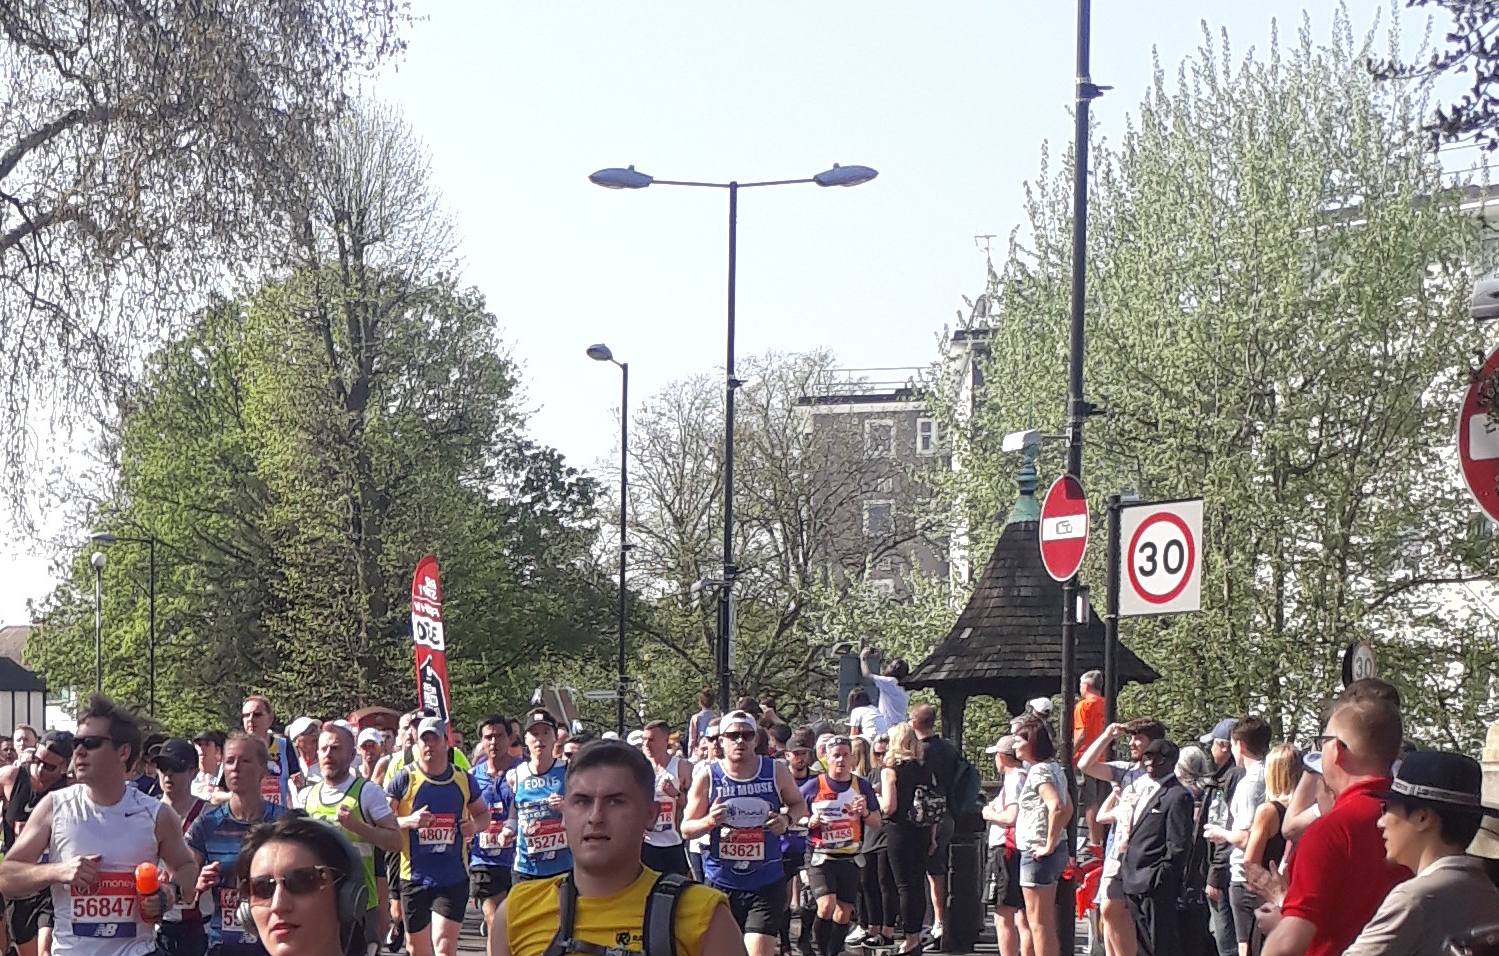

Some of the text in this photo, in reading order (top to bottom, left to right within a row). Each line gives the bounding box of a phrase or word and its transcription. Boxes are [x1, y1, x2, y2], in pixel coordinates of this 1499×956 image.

[1138, 539, 1185, 577] 30
[1356, 657, 1372, 678] 30
[525, 776, 560, 790] EDDIE
[737, 781, 774, 796] MOUSE
[720, 842, 762, 858] 43621
[73, 897, 135, 918] 56847
